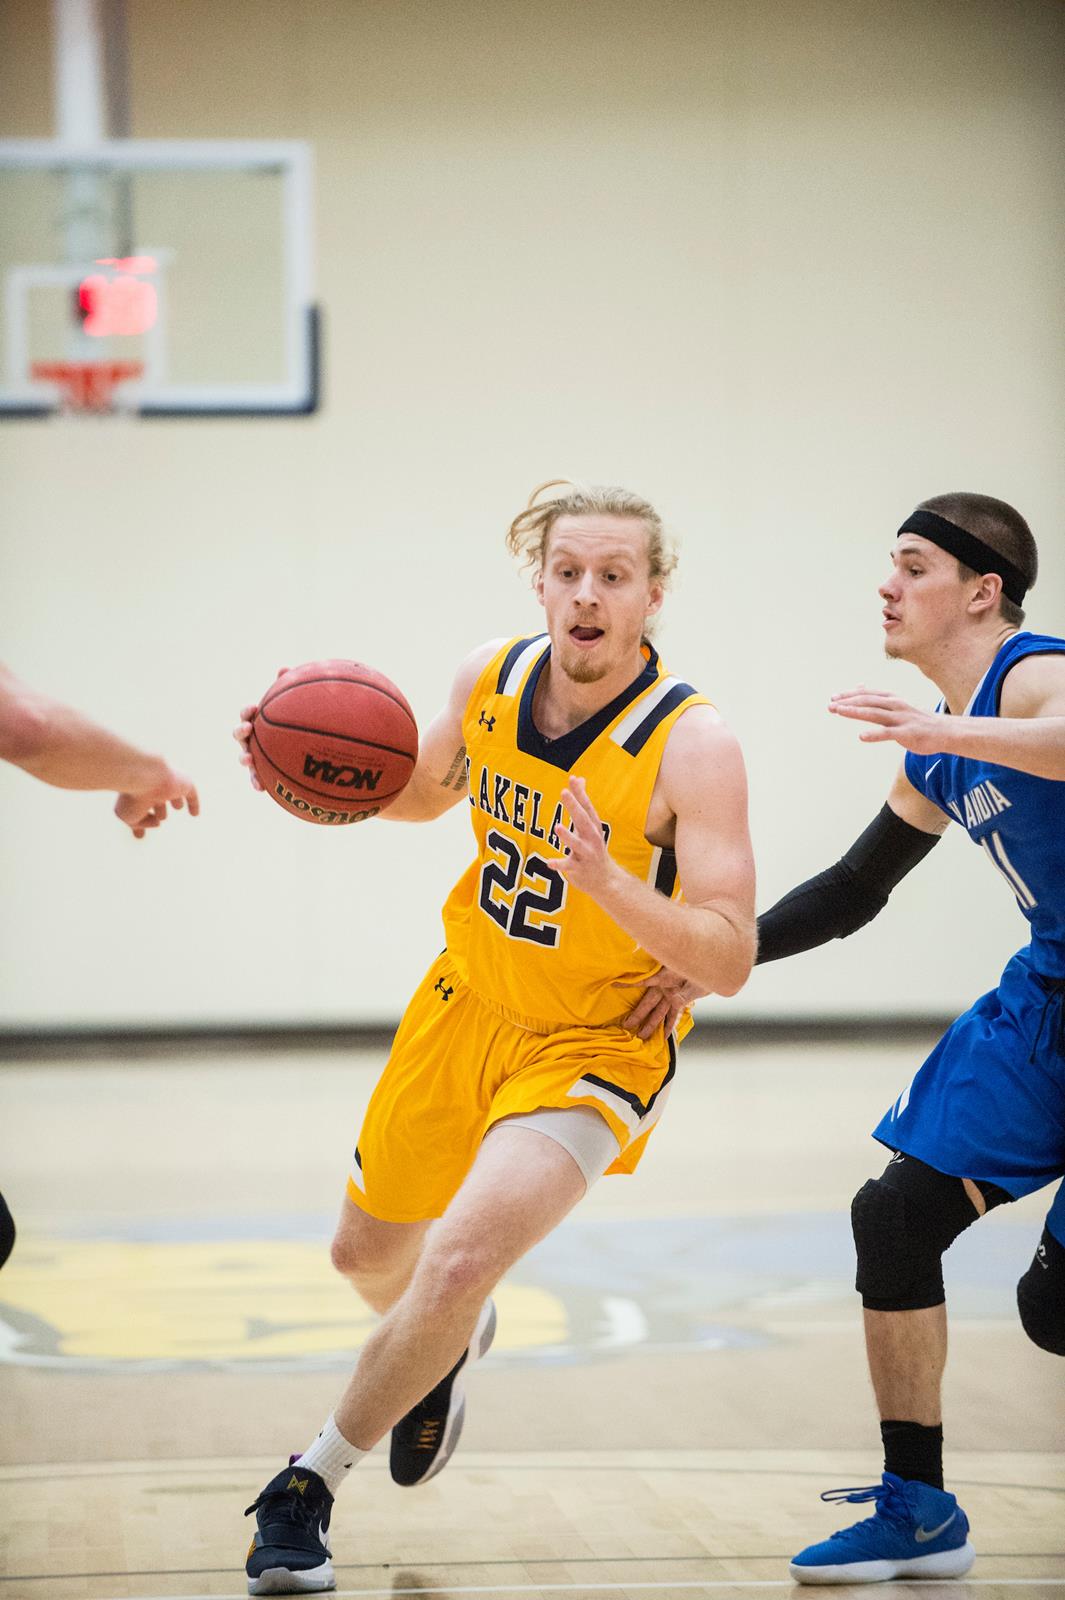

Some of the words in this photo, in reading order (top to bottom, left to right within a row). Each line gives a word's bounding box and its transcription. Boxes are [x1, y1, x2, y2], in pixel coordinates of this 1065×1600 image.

[303, 753, 383, 791] NCAA
[465, 755, 612, 856] AKELA
[478, 828, 569, 950] 22
